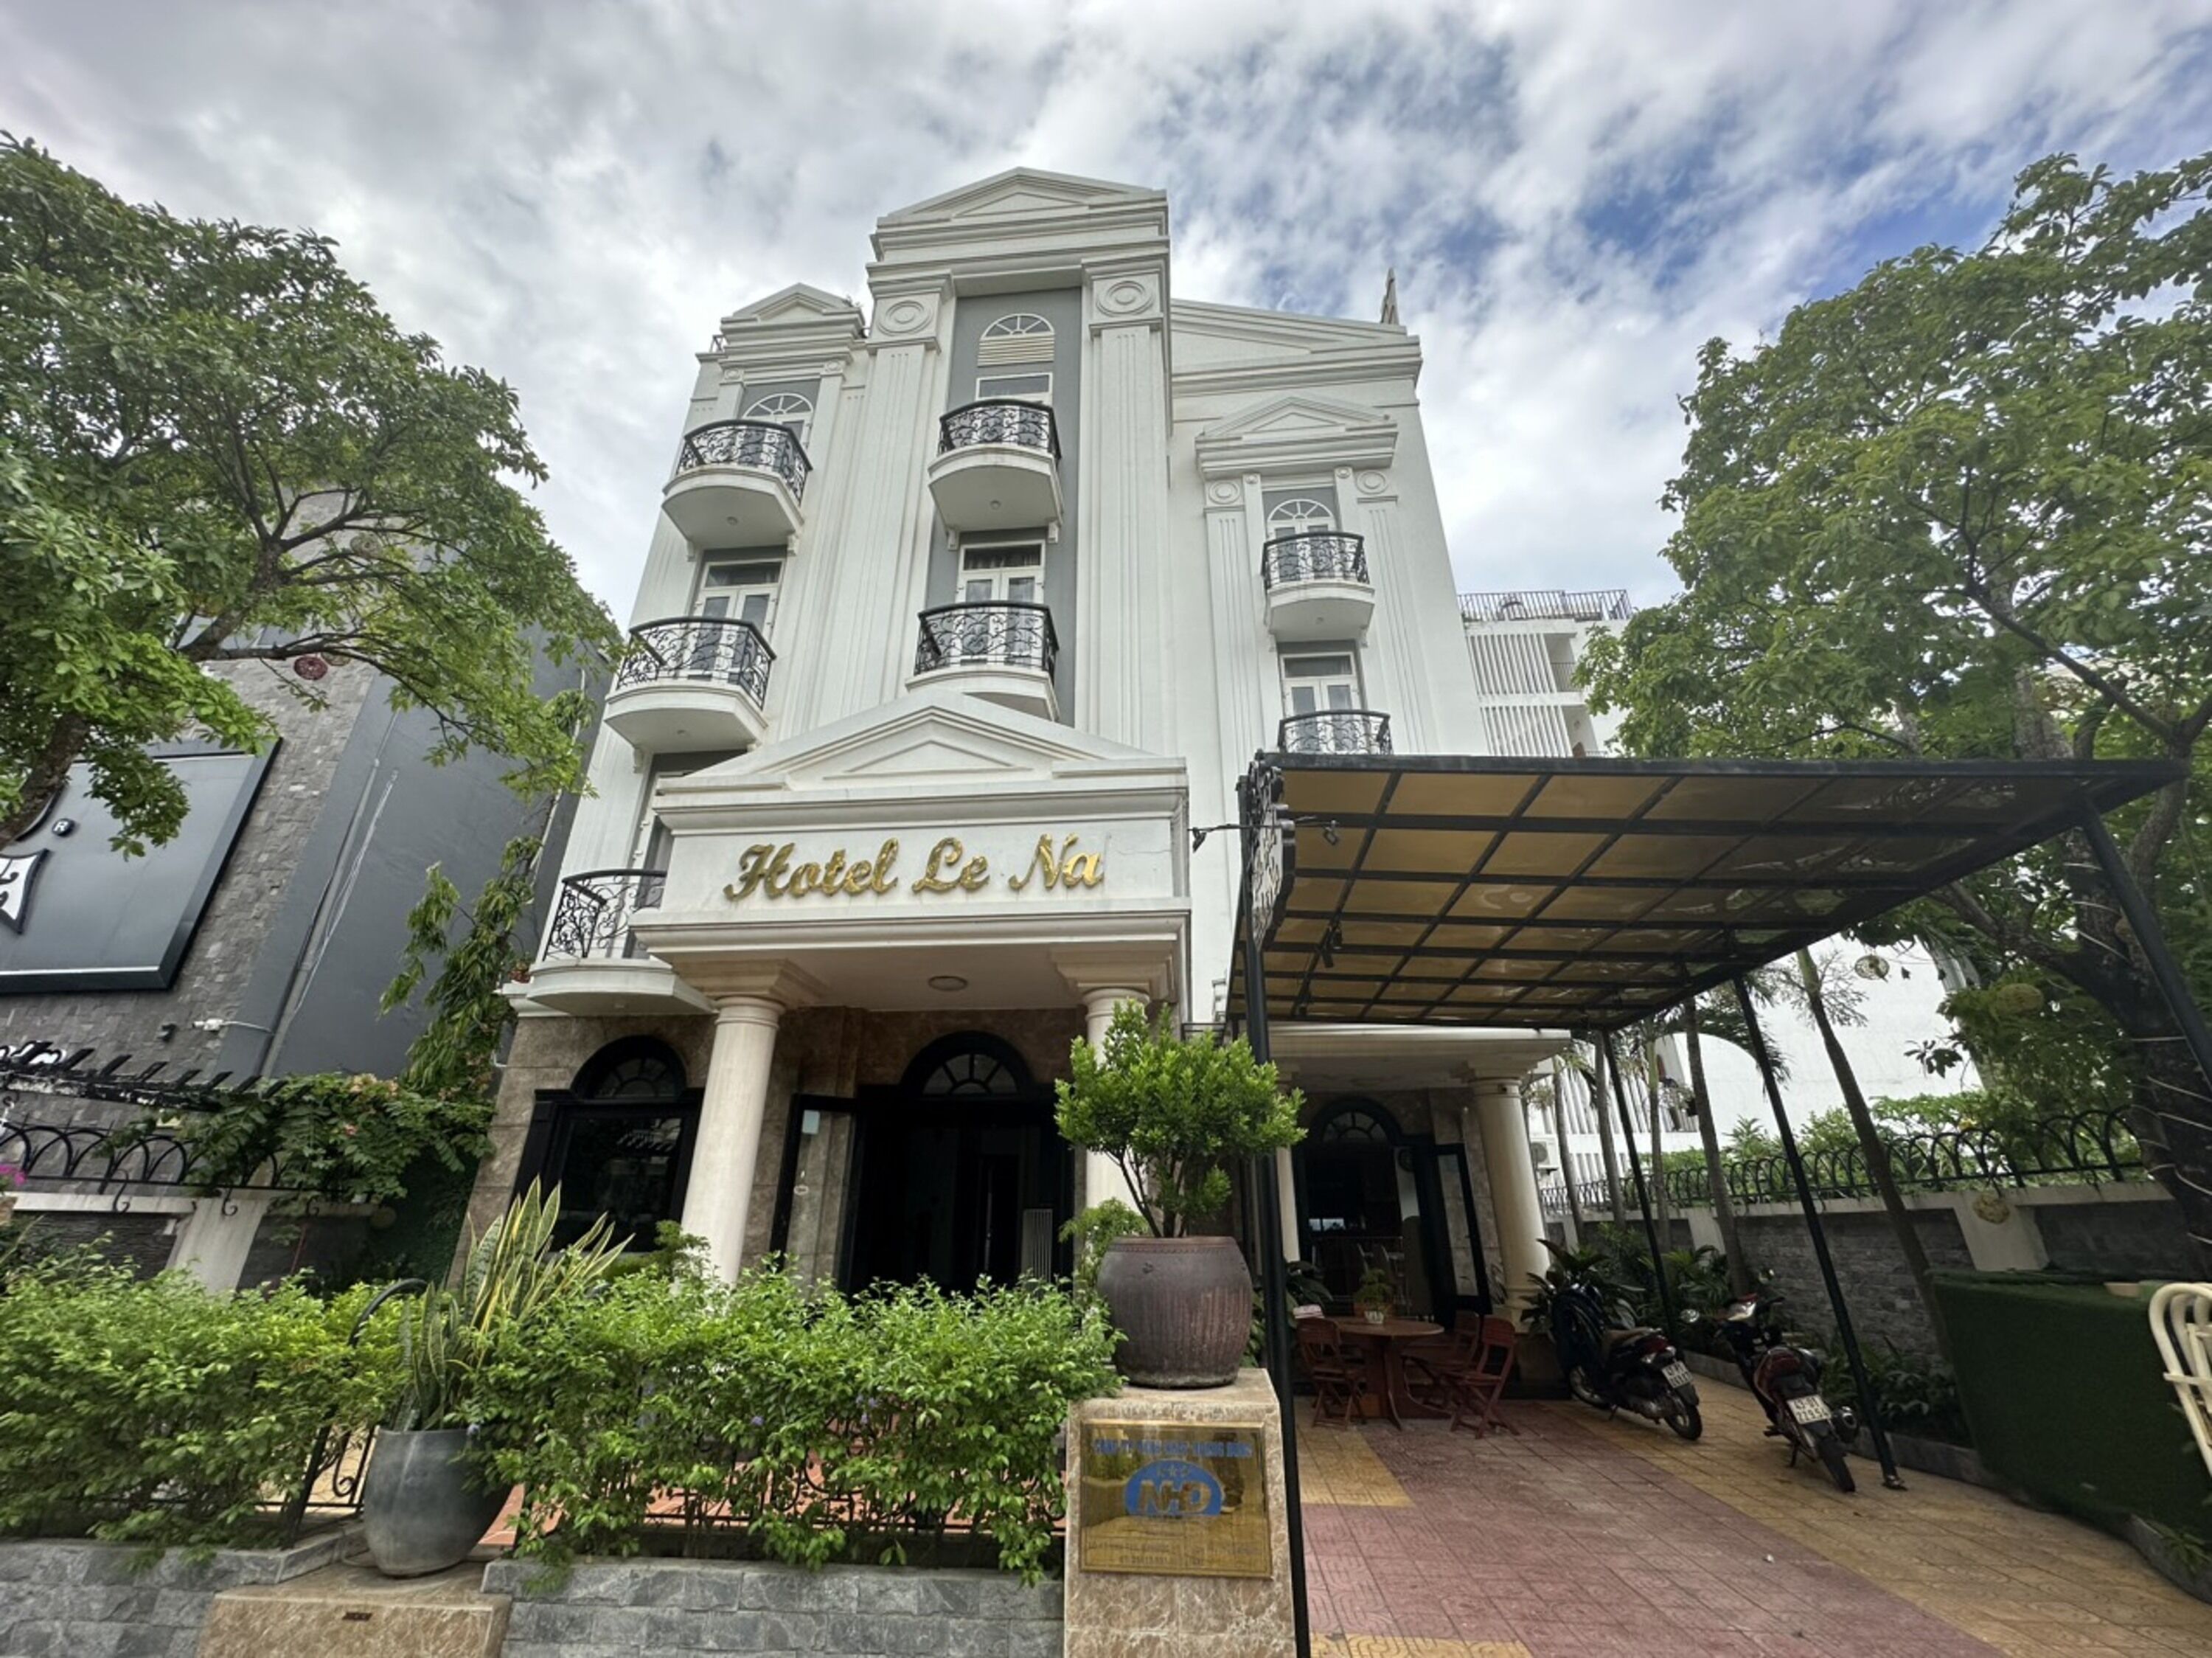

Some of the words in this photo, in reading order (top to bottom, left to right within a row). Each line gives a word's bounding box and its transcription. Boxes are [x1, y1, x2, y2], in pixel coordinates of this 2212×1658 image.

[723, 837, 899, 901] Hotel
[911, 836, 990, 894] Le
[1008, 833, 1105, 891] Na
